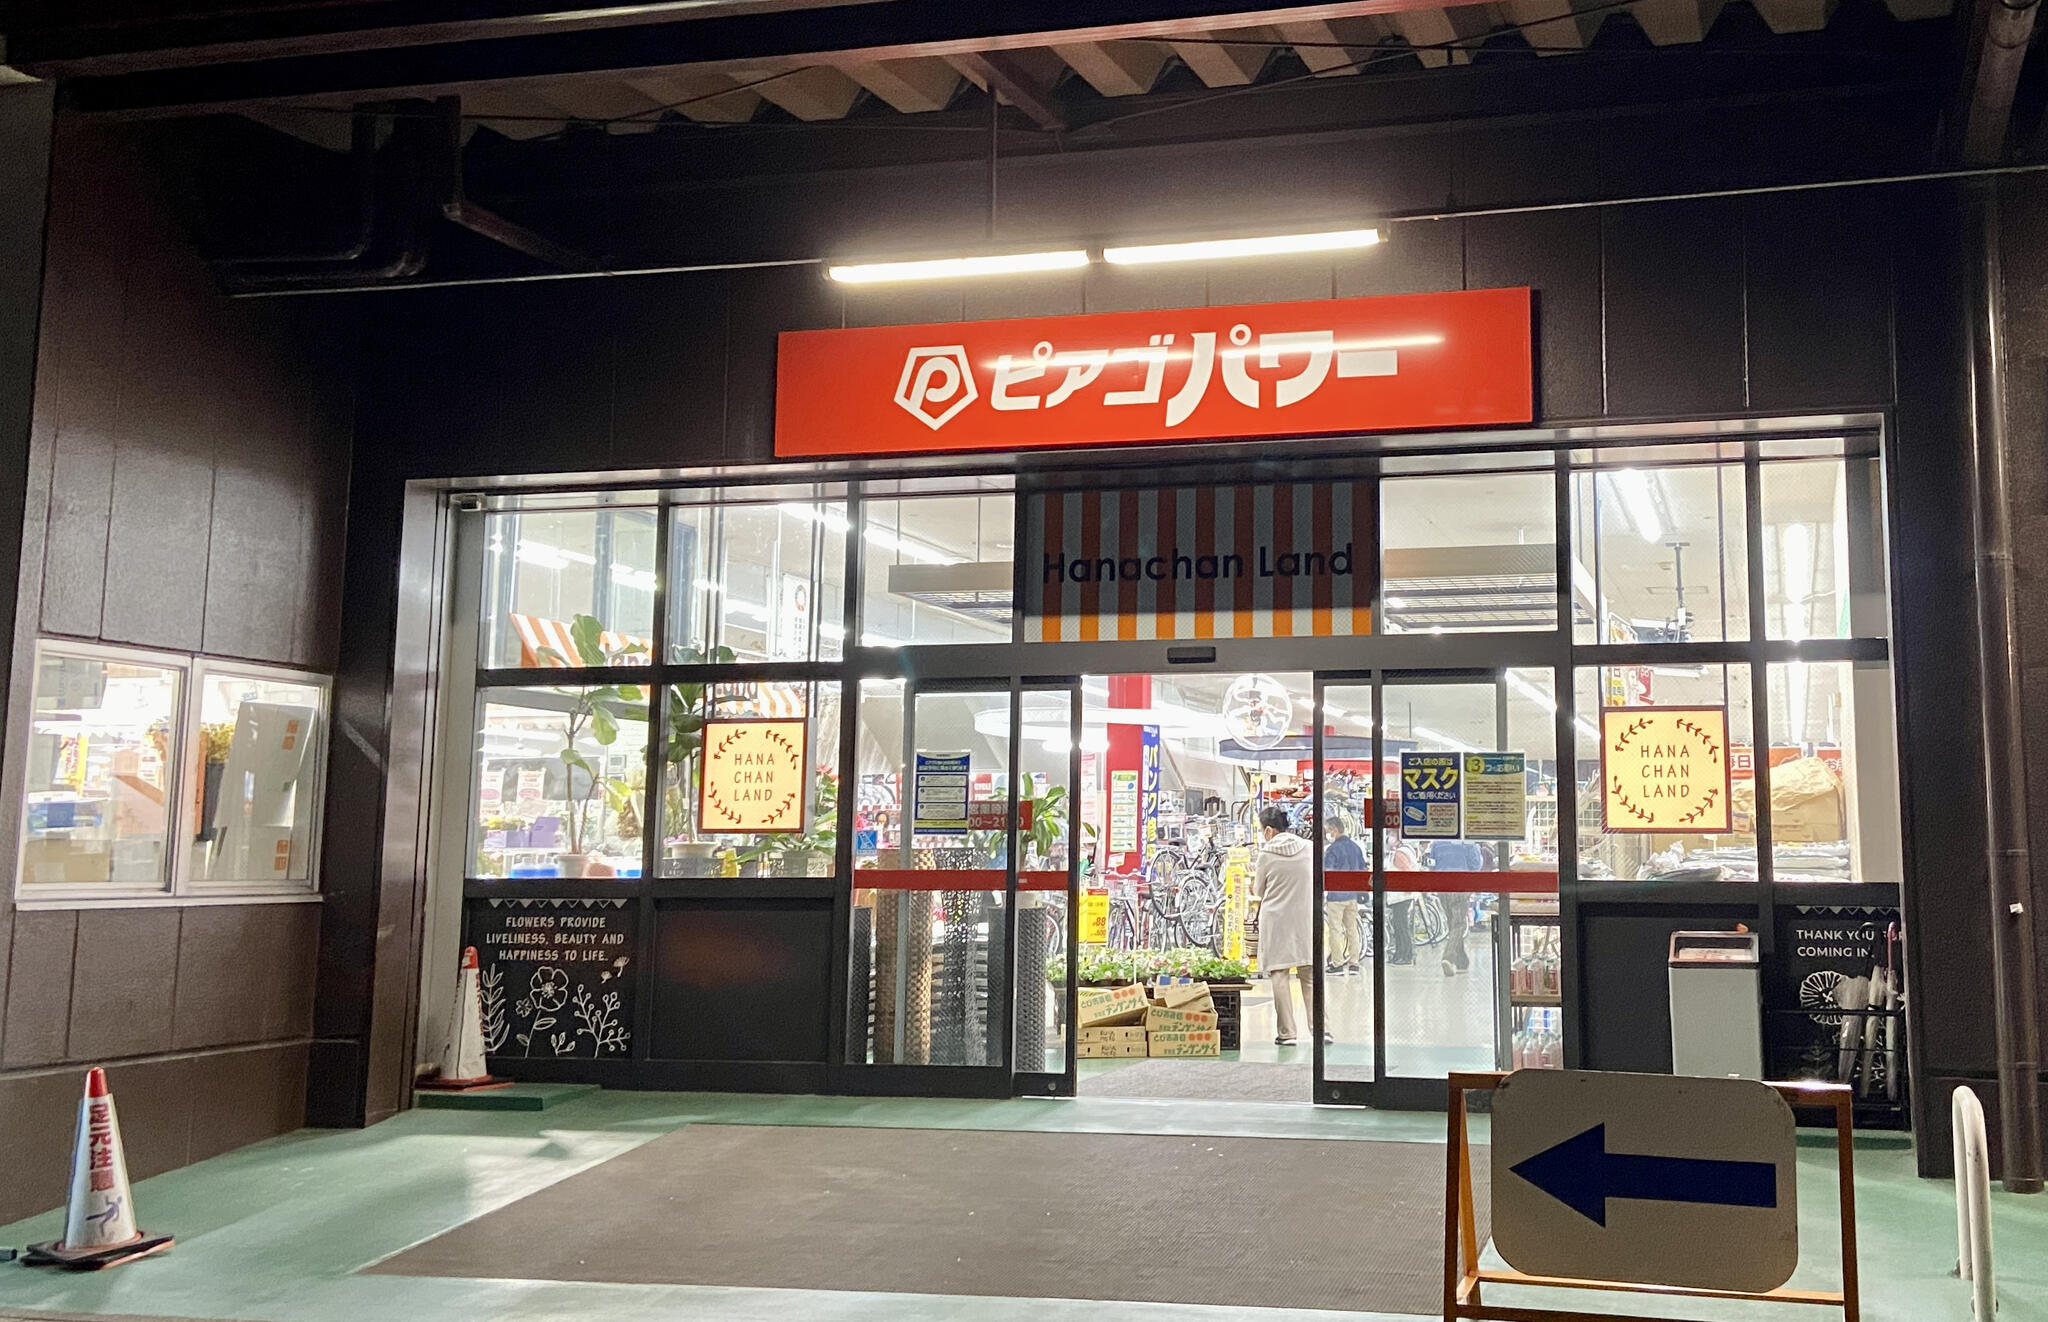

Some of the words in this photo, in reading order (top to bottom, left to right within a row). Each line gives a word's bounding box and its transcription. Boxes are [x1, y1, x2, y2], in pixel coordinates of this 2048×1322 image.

[990, 323, 1398, 428] ピアゴパワー
[1043, 548, 1243, 583] Hanachan
[1259, 543, 1352, 577] Land
[1640, 745, 1690, 758] HANA
[734, 753, 775, 765] HANA
[734, 771, 774, 784] CHAN
[1641, 765, 1690, 778] CHAN
[1402, 767, 1459, 790] マスク
[734, 789, 772, 802] LAND
[1642, 785, 1690, 798] LAND
[505, 916, 555, 928] FLOWERS
[560, 916, 606, 928] PROVIDE
[554, 933, 597, 944] BEAUTY
[602, 933, 624, 944] AND
[1796, 929, 1843, 941] THANK
[499, 949, 559, 961] HAPPINESS
[564, 949, 577, 961] TO
[582, 949, 609, 961] LIFE.
[1797, 946, 1853, 958] COMING
